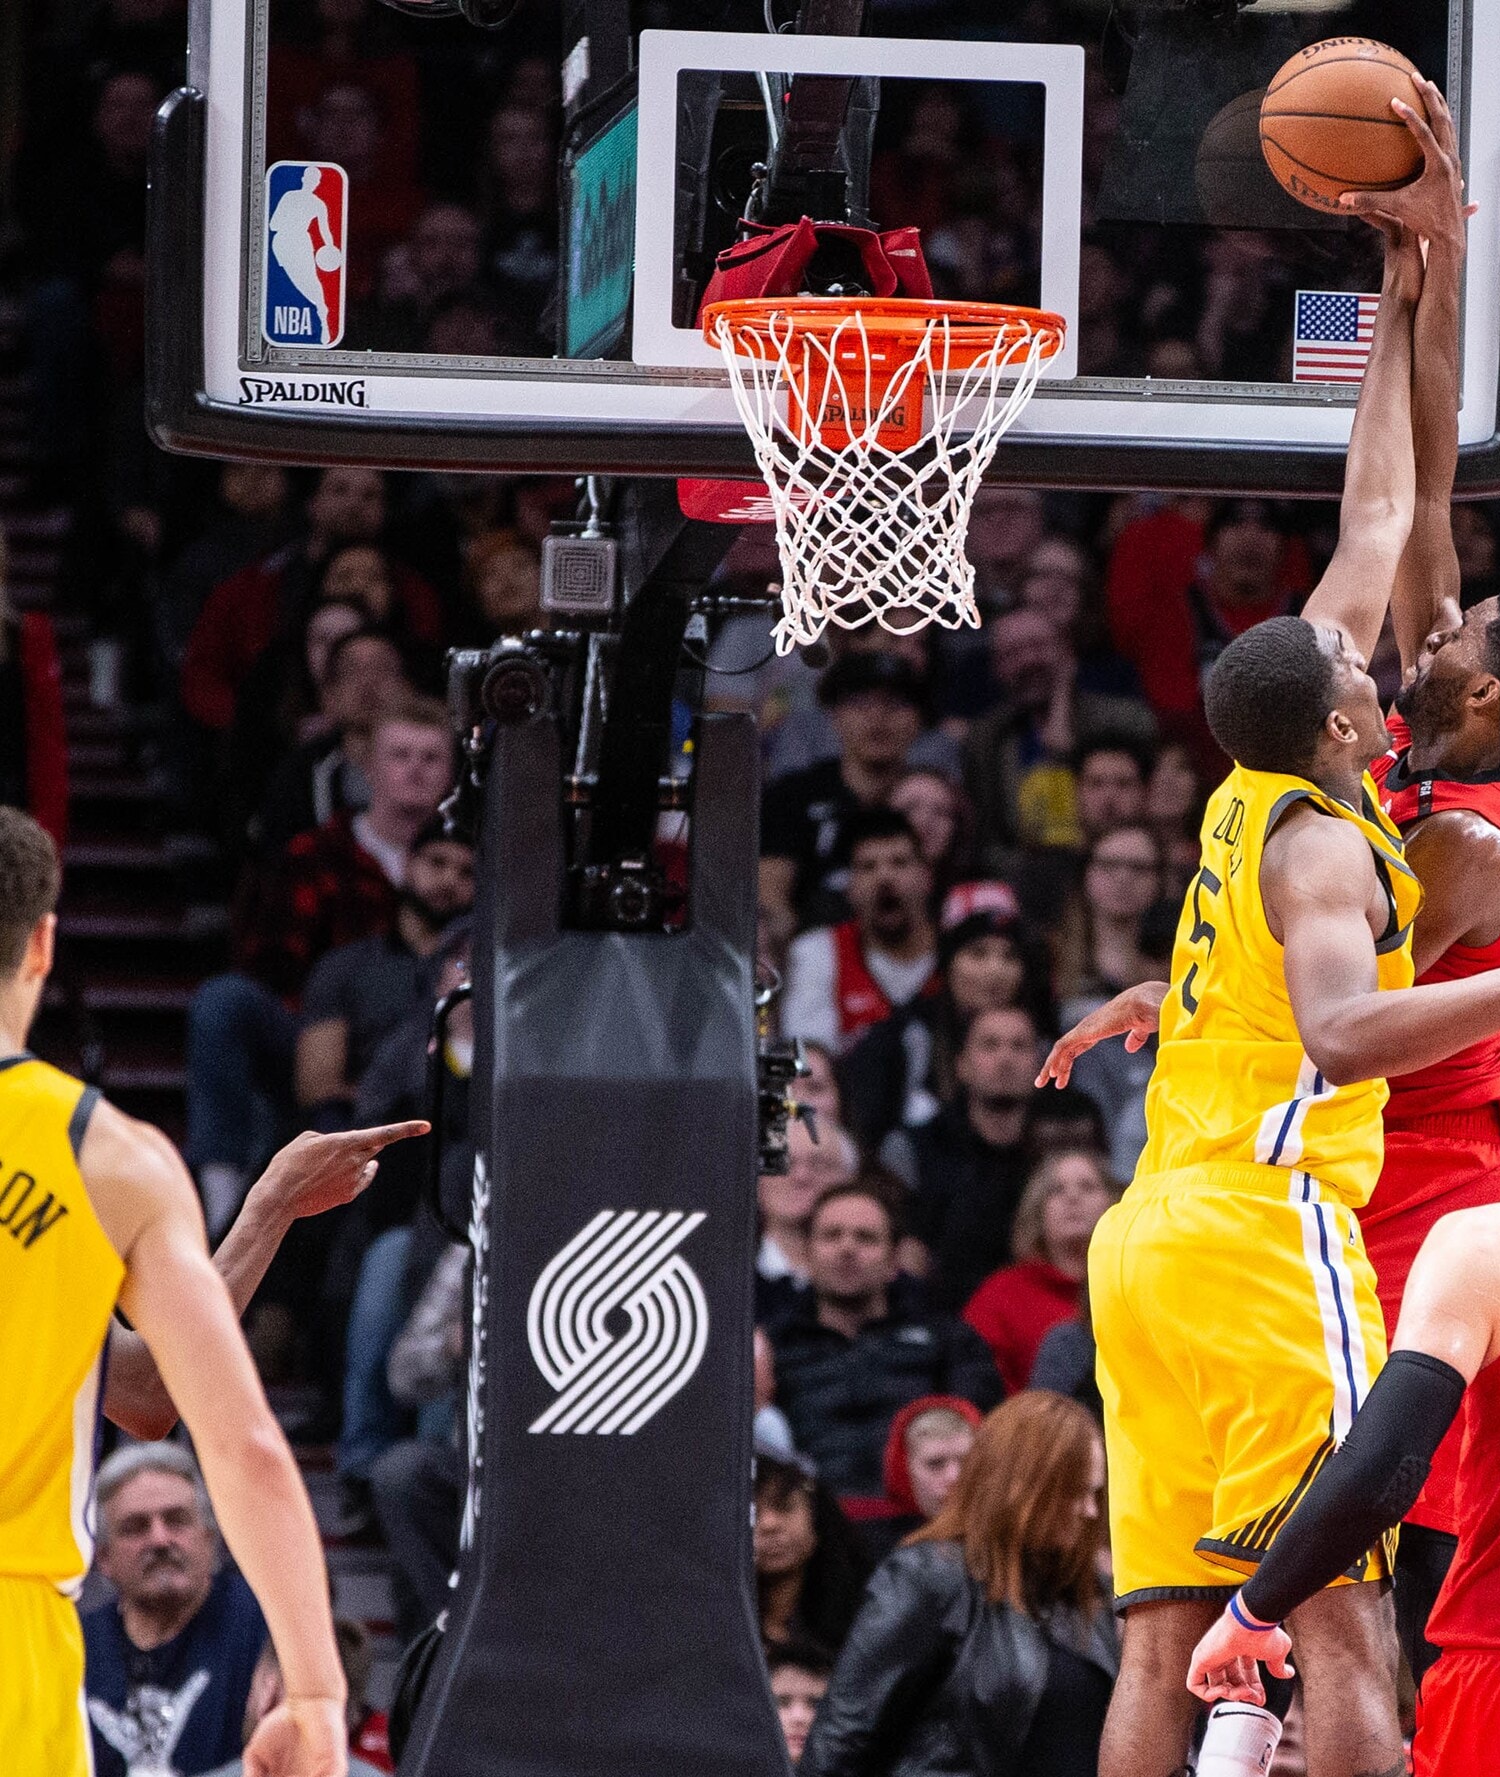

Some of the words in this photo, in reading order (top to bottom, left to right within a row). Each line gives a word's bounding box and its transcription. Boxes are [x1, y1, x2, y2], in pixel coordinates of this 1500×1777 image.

[274, 306, 312, 336] NBA
[239, 377, 365, 408] SPALDING
[1182, 866, 1222, 1016] 5
[0, 1161, 68, 1249] ON
